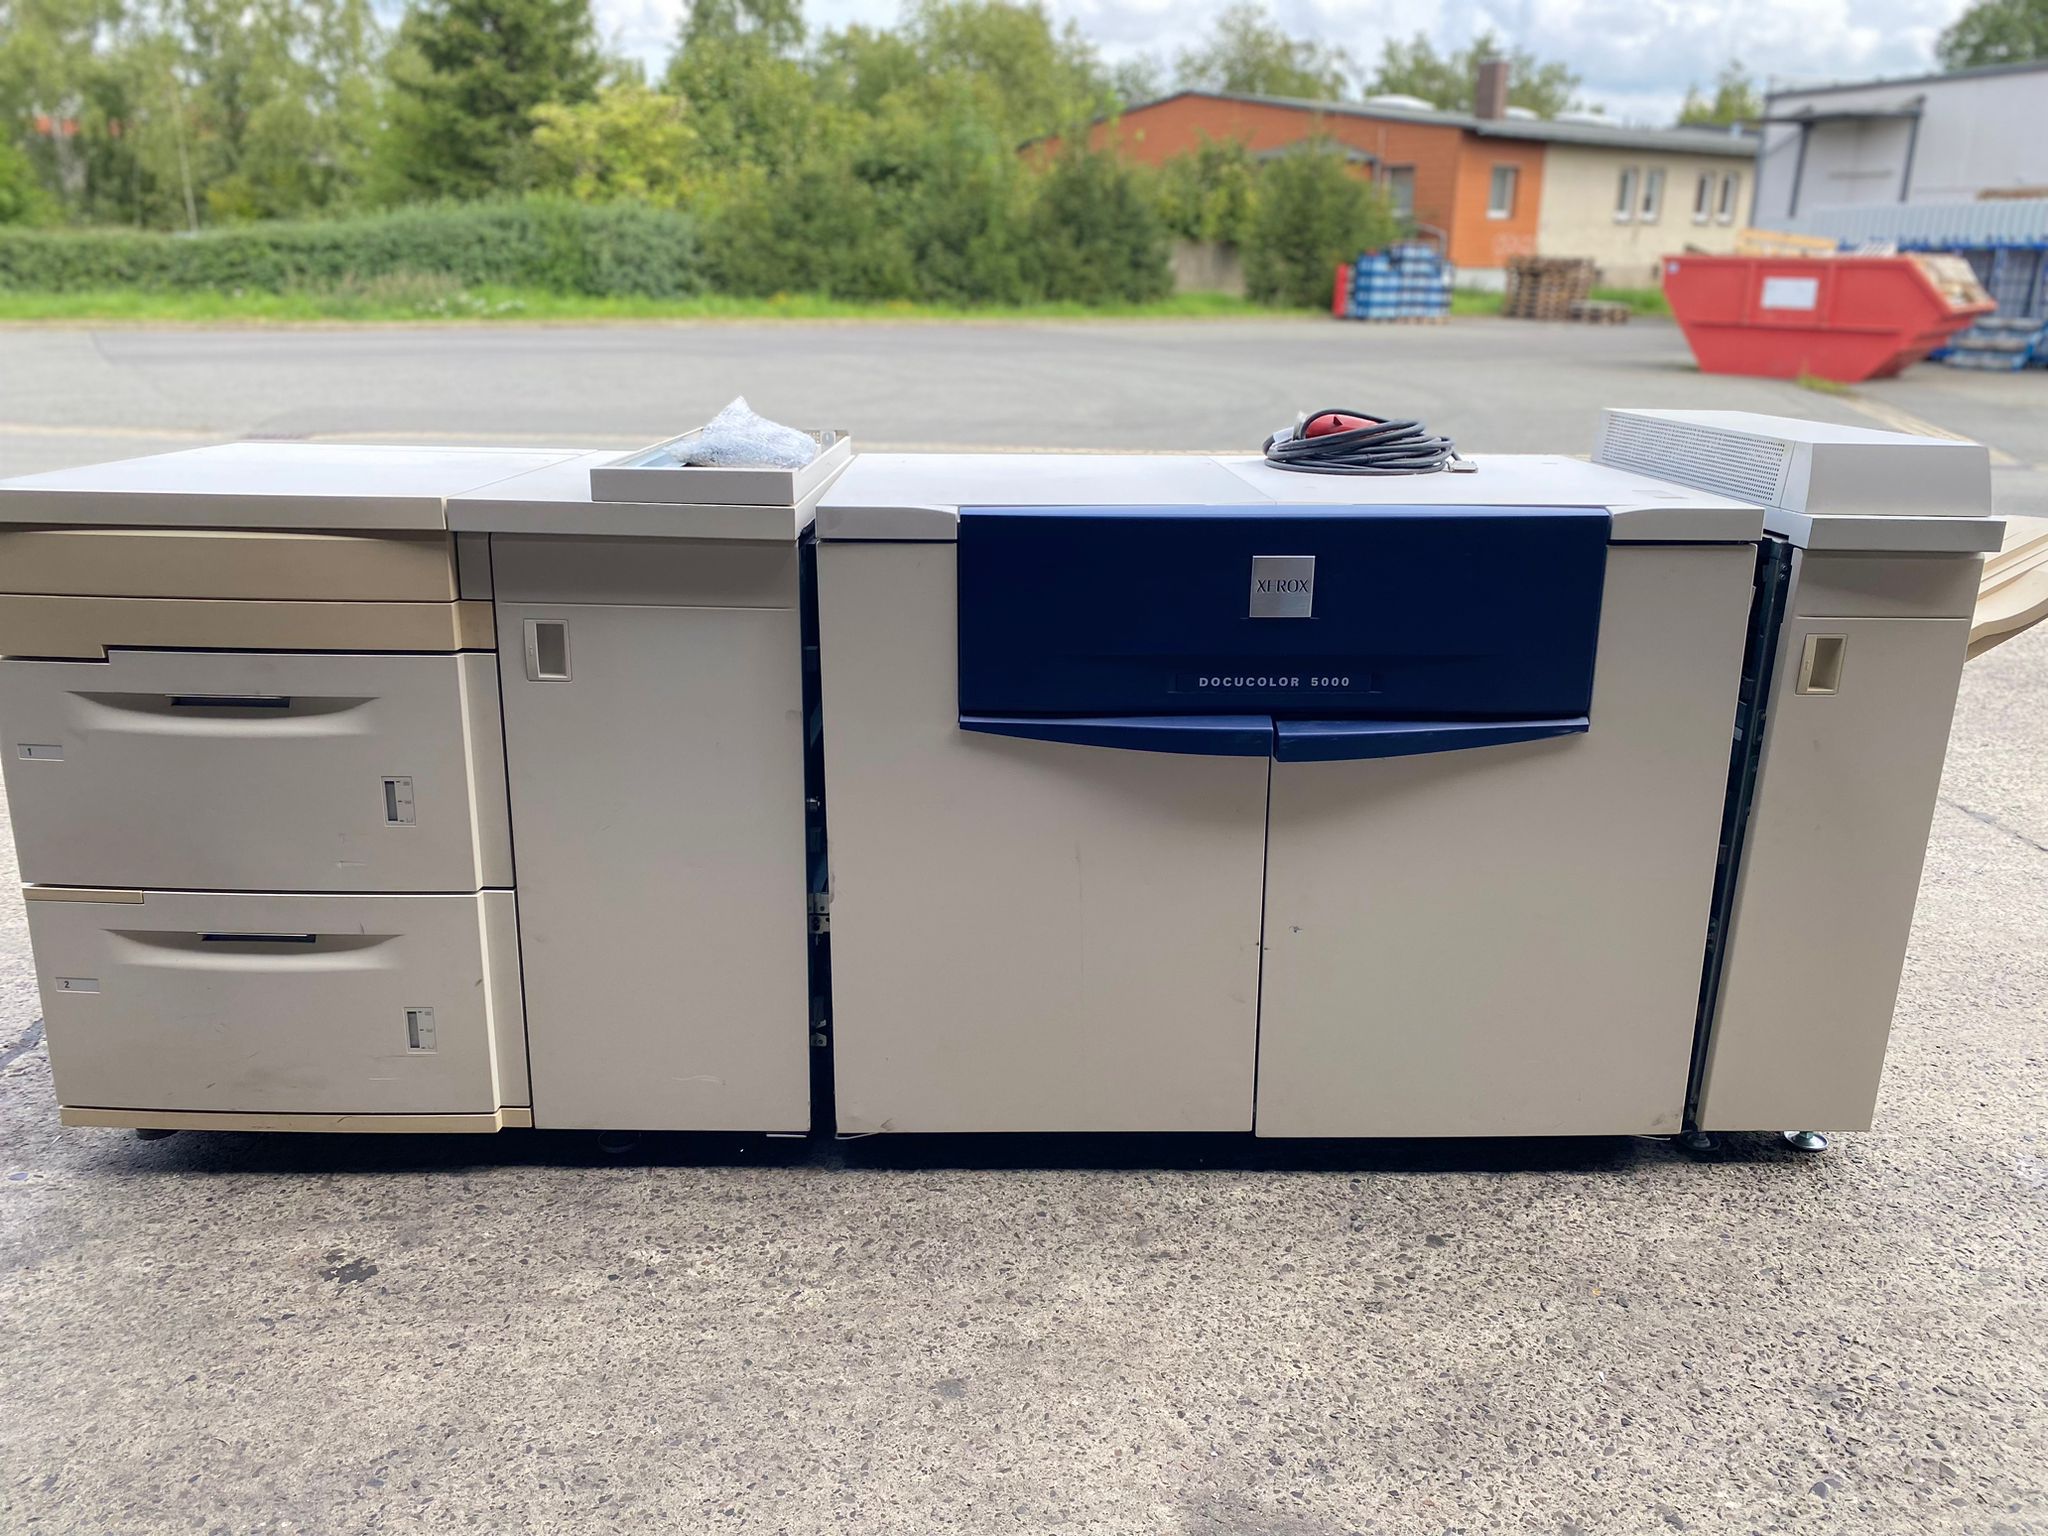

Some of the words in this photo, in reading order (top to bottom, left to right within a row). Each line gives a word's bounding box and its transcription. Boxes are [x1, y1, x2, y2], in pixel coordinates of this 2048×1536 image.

[1256, 579, 1309, 593] XEROX
[1199, 677, 1299, 687] DOCUCOLOR
[1311, 677, 1350, 687] 5000
[64, 980, 71, 989] 2
